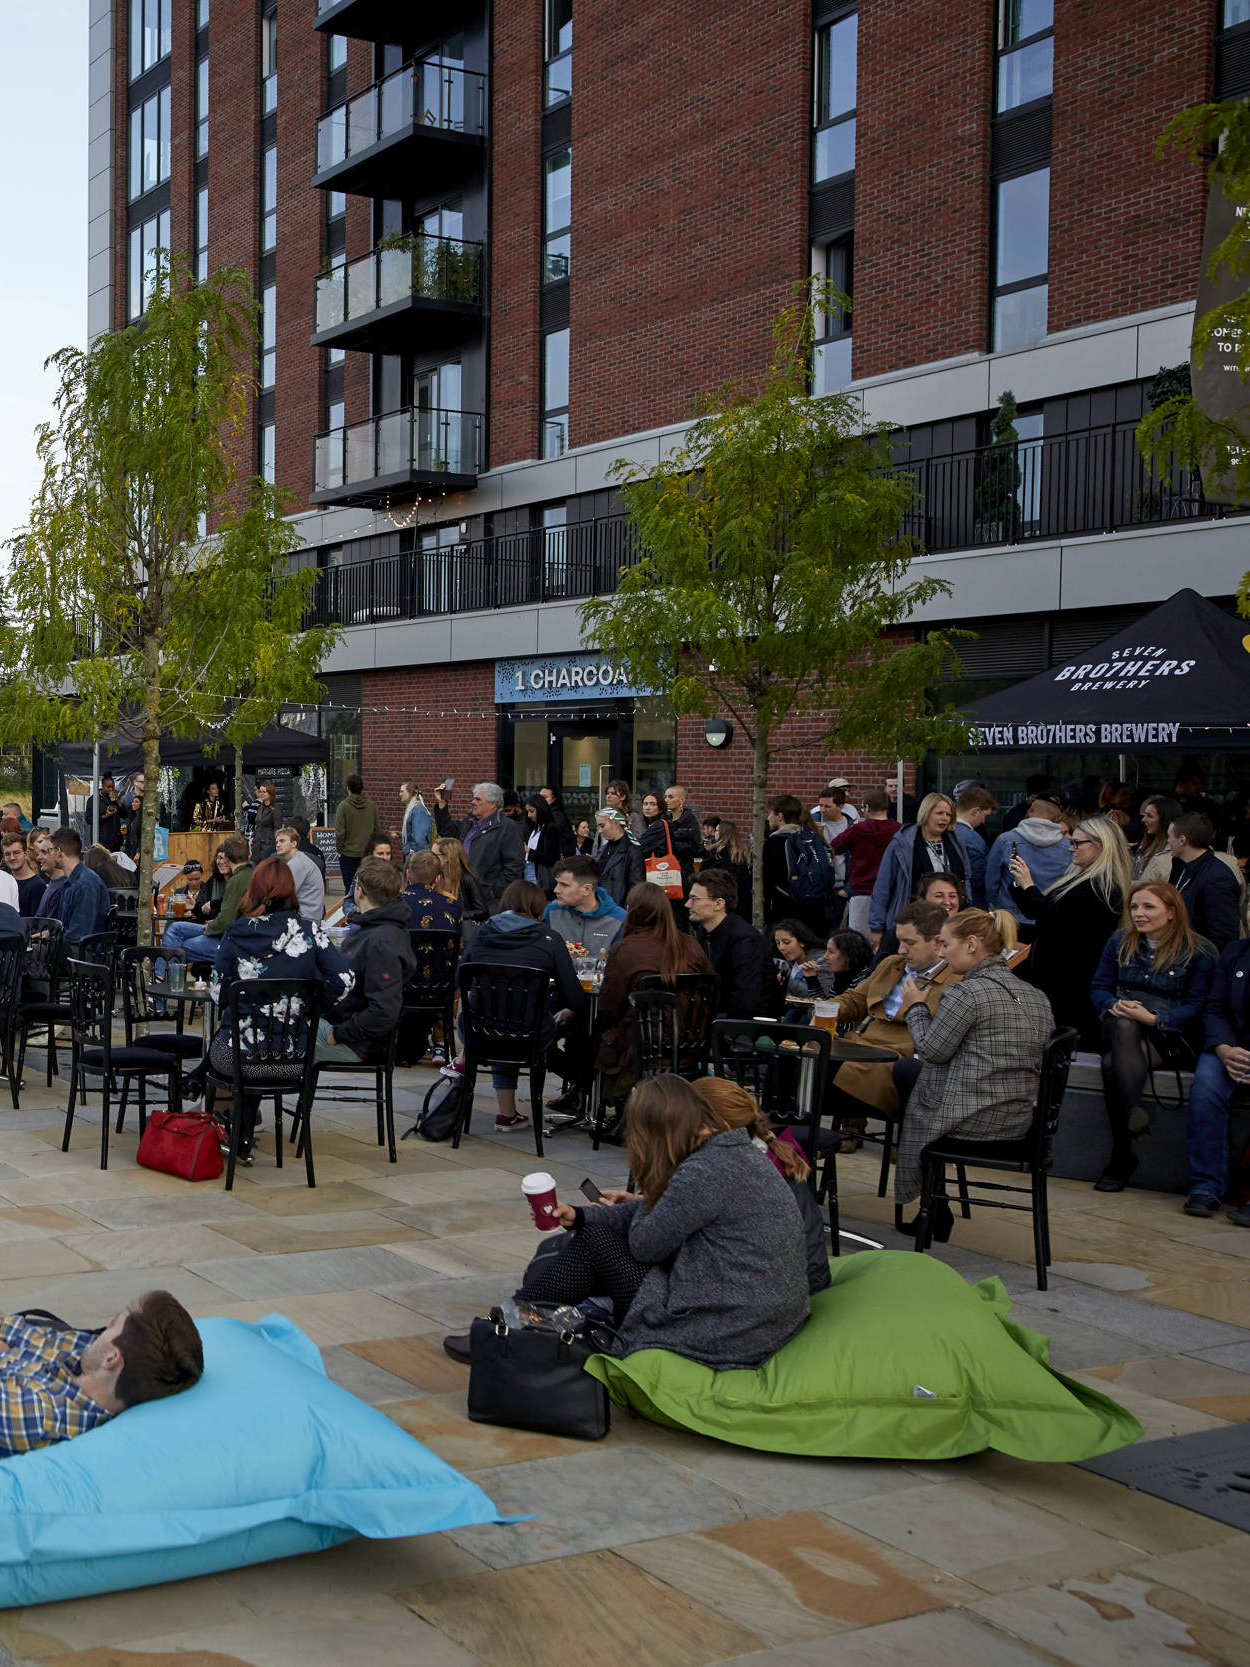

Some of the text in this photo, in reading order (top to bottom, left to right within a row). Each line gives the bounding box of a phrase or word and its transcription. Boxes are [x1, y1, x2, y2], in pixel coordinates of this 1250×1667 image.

[1217, 342, 1232, 353] TO
[1111, 646, 1167, 660] SEVEN
[515, 665, 634, 691] 1 CHARCOA
[1054, 660, 1196, 681] BRO7HERS
[1070, 680, 1150, 691] BREWERY
[968, 723, 1180, 746] SEVEN BRO7HERS BREWERY
